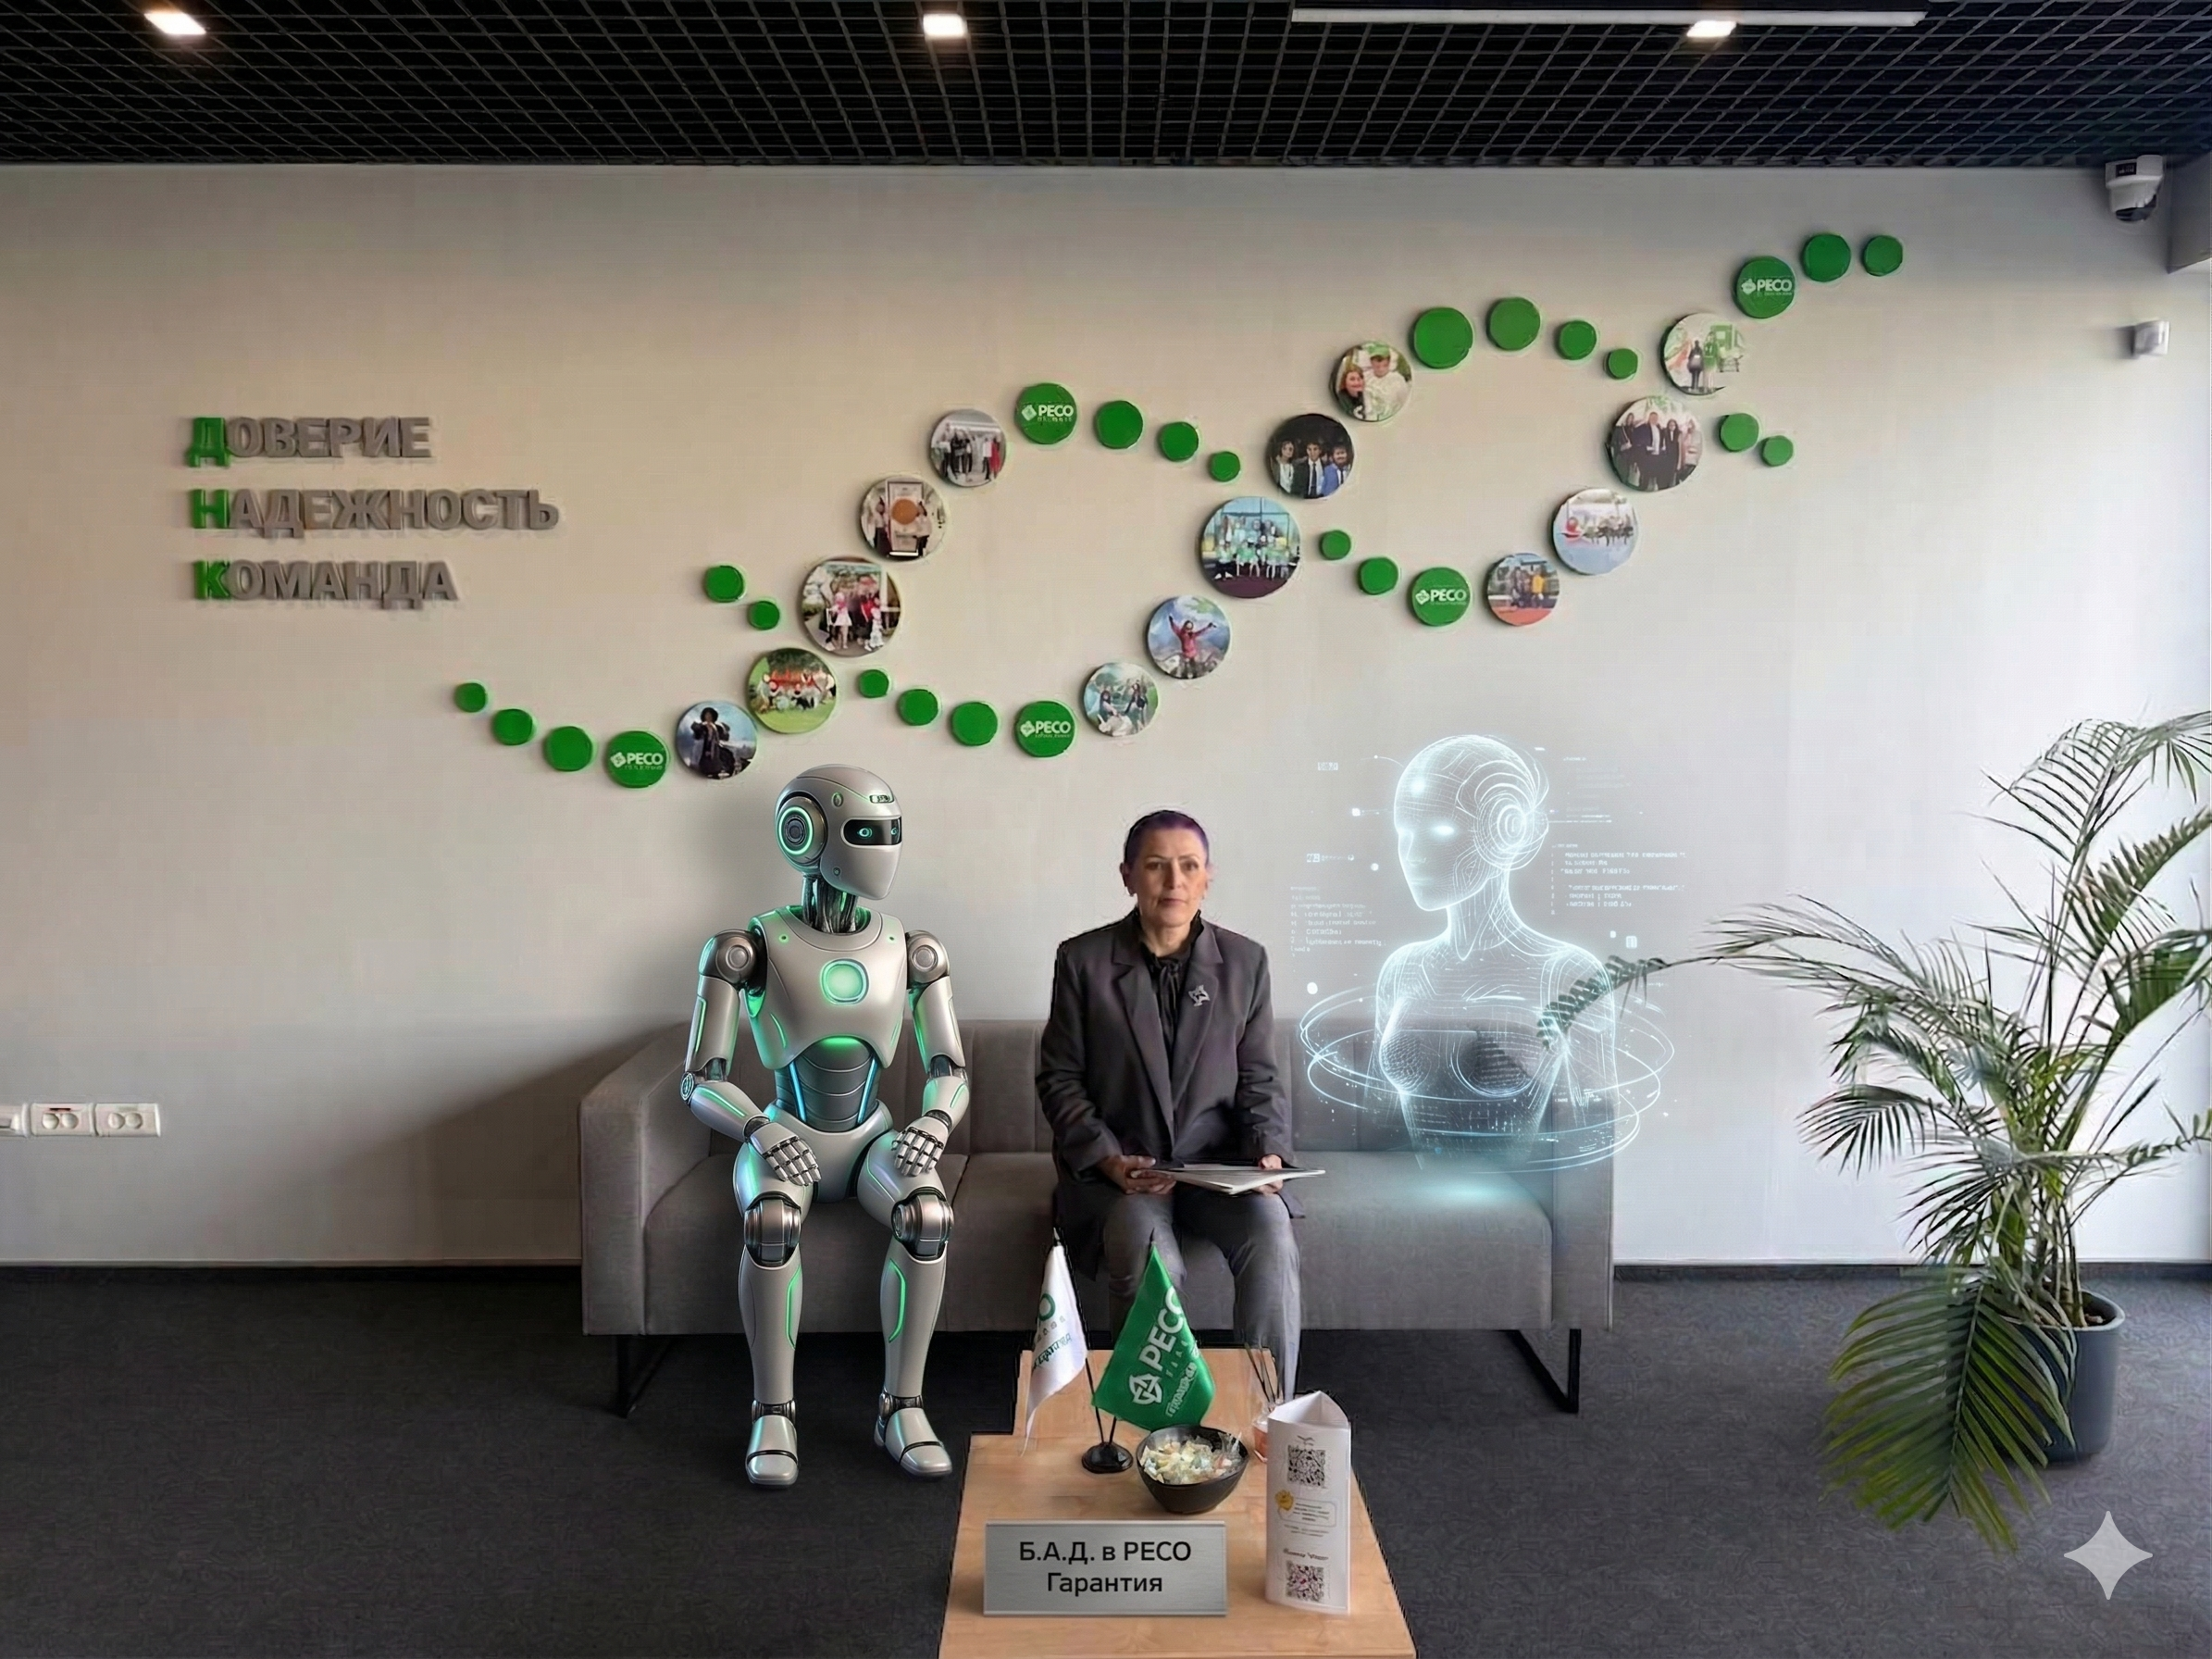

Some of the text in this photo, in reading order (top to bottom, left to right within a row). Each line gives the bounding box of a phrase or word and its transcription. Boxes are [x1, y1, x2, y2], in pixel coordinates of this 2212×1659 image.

[1757, 278, 1792, 292] РЕСО
[1038, 404, 1074, 418] РЕСО
[186, 417, 431, 467] ДОВЕРИЕ
[190, 489, 559, 538] НАДЕЖНОСТЬ
[193, 560, 458, 609] КОМАНДА
[1430, 588, 1467, 602] РЕСО
[1035, 720, 1071, 734] РЕСО
[627, 752, 664, 766] РЕСО
[1019, 1540, 1192, 1565] Б.А.Д. в РЕСО
[1047, 1572, 1162, 1597] Гарантия
